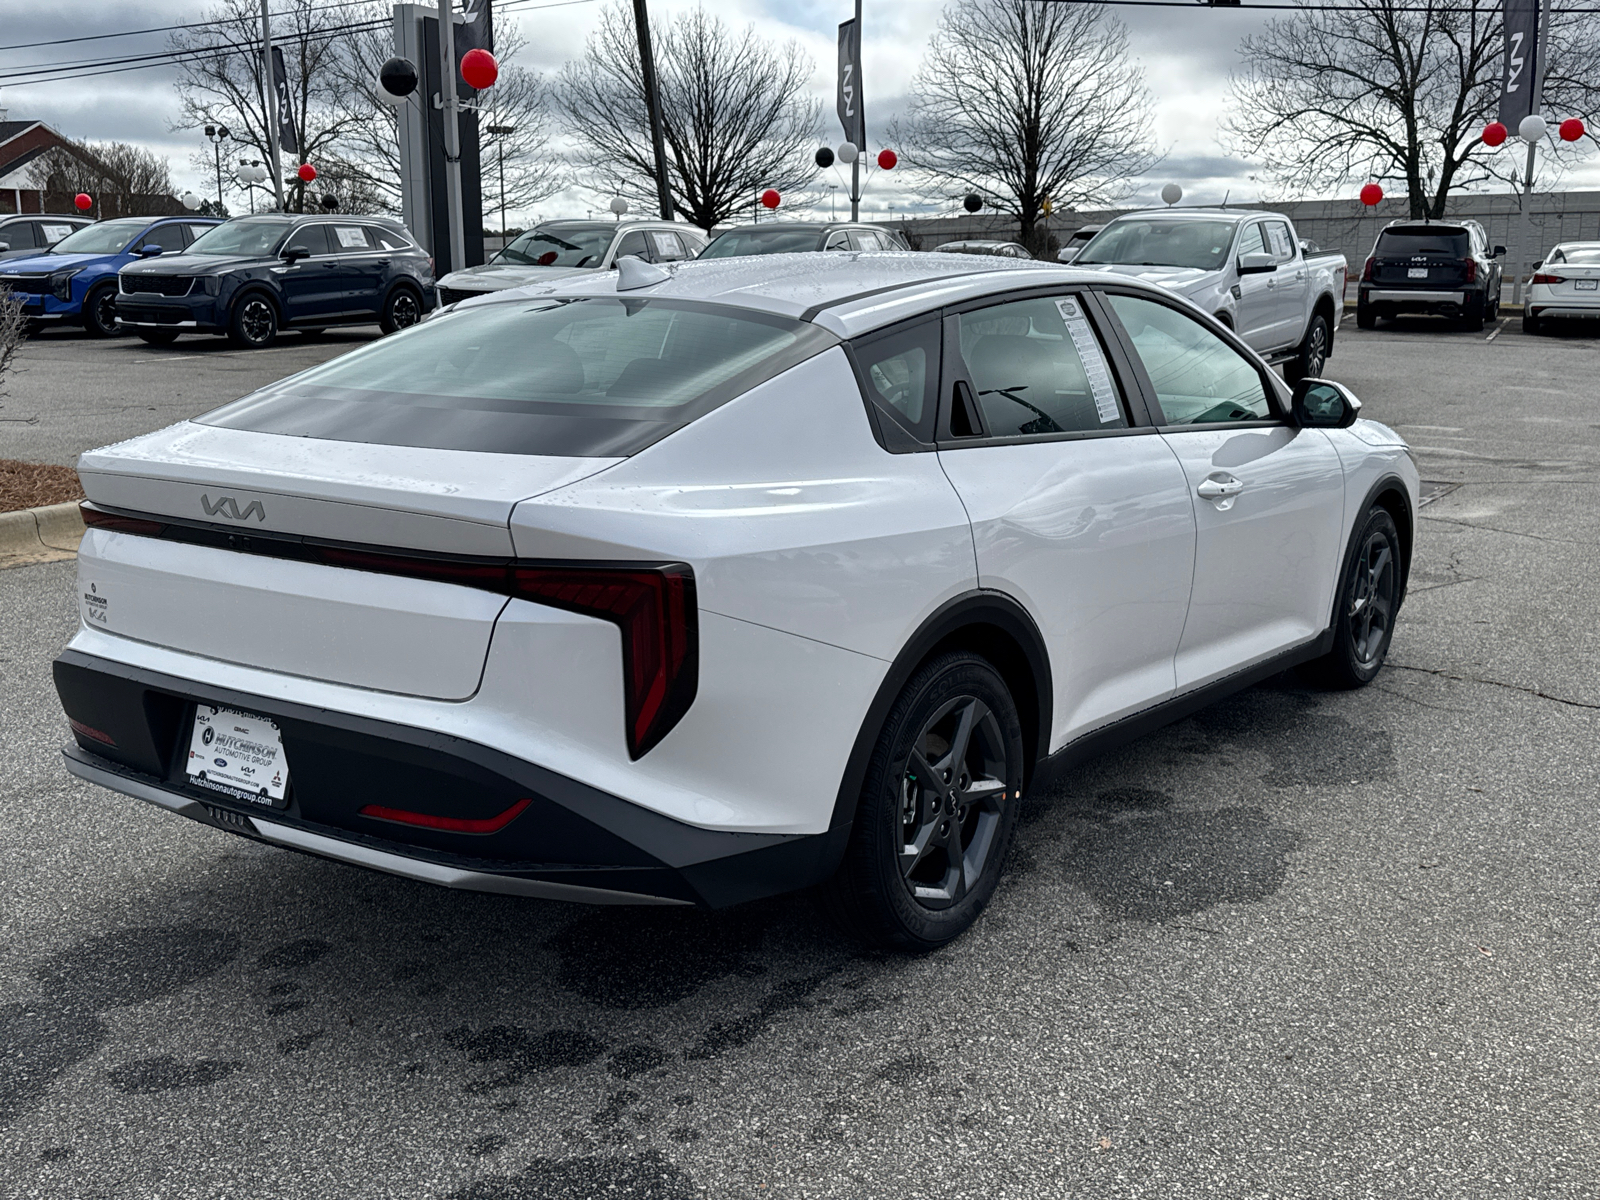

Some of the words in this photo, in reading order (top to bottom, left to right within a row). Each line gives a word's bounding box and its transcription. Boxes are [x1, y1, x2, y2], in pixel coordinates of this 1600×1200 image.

[200, 493, 266, 522] KIA
[234, 726, 249, 735] GMC
[214, 733, 278, 759] HUTCHINSON
[214, 746, 251, 762] AUTOMOTIVE
[251, 755, 272, 767] GROUP
[189, 775, 273, 806] Hutchinsonautogroup.com
